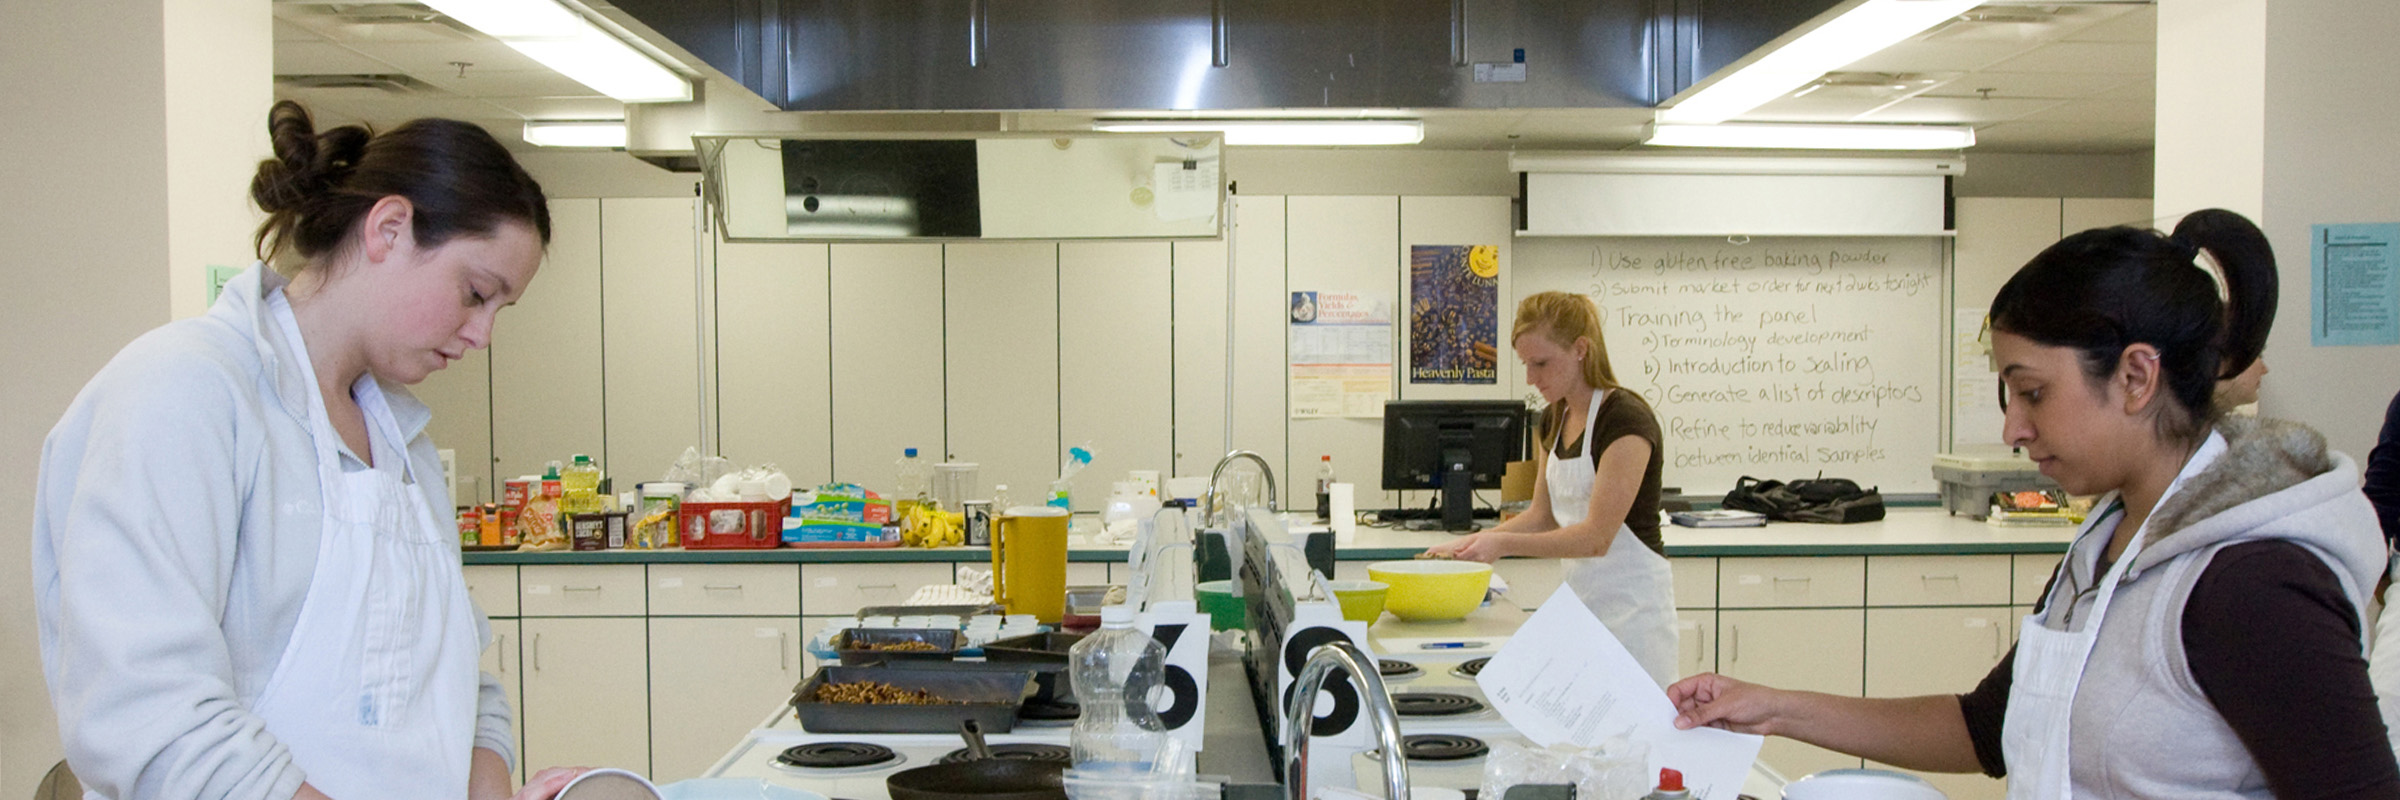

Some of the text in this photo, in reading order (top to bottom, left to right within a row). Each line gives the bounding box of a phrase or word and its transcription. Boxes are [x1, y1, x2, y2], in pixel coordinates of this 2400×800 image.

[1609, 251, 1642, 272] Use
[1654, 251, 1708, 276] gluten
[1713, 249, 1756, 272] free
[1765, 248, 1823, 276] baking
[1829, 249, 1890, 270] powder
[1611, 281, 1668, 297] Submit
[1678, 276, 1741, 295] market
[1746, 277, 1790, 293] order
[1796, 277, 1812, 294] for
[1883, 272, 1932, 297] tonight
[1318, 309, 1370, 319] Percentages
[1616, 304, 1708, 333] Training
[1713, 303, 1744, 324] the
[1760, 303, 1817, 330] panel
[1662, 330, 1757, 354] Terminology
[1767, 324, 1874, 345] development
[1412, 364, 1496, 381] Heavenly Pasta
[1668, 355, 1773, 376] Introduction
[1778, 353, 1797, 374] to
[1667, 384, 1751, 404] Generate
[1759, 388, 1771, 402] a
[1773, 383, 1801, 403] list
[1807, 380, 1825, 402] of
[1831, 380, 1922, 408] descriptors
[1670, 416, 1730, 441] Refine
[1739, 416, 1758, 438] to
[1804, 415, 1879, 449] variability
[1674, 446, 1742, 469] between
[1749, 444, 1810, 464] identical
[1122, 623, 1199, 731] 6
[1283, 626, 1360, 737] 8
